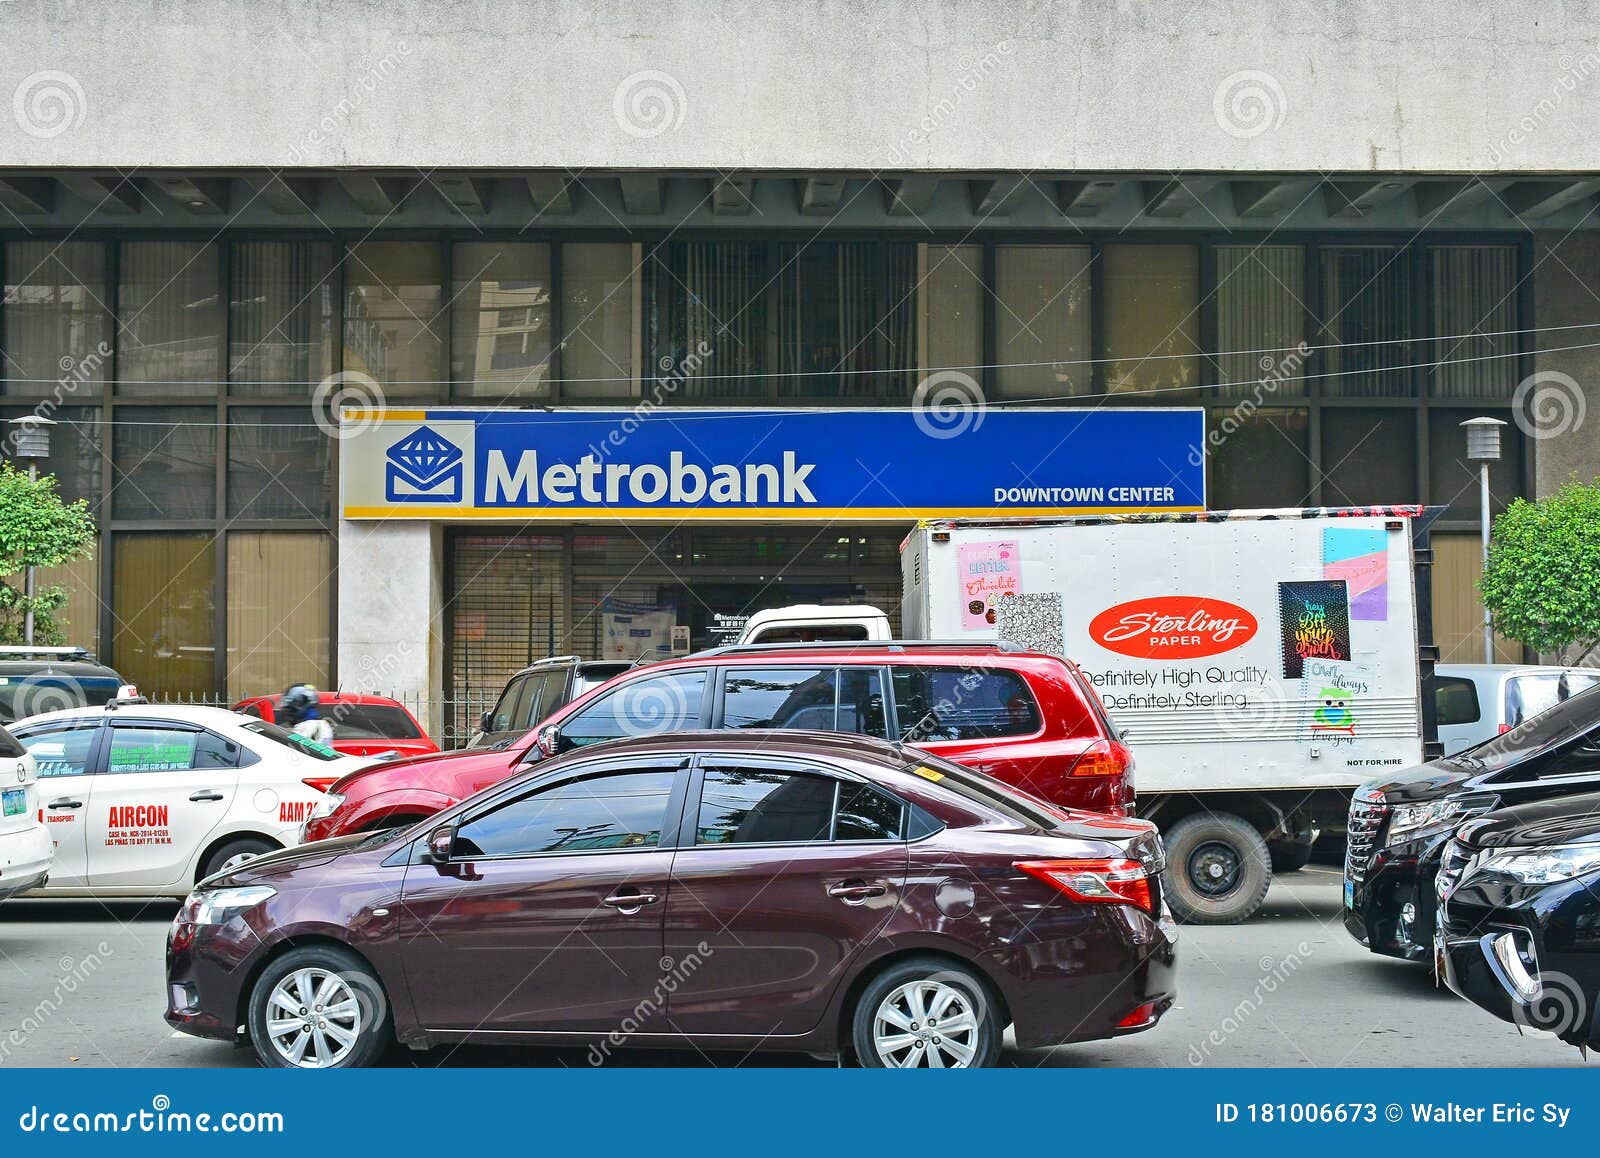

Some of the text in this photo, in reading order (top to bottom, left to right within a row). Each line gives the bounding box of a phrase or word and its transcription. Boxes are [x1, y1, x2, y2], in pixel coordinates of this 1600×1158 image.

[484, 449, 817, 503] Metrobank
[994, 487, 1174, 502] DOWNTOWN CENTER
[1103, 609, 1249, 642] Sterling
[1150, 635, 1201, 647] PAPER
[1162, 668, 1201, 688] High
[1206, 666, 1271, 686] Quality.
[1102, 693, 1181, 711] Definitely
[47, 815, 75, 823] TRANSPORT
[109, 805, 168, 828] AIRCON
[279, 802, 304, 822] AAM
